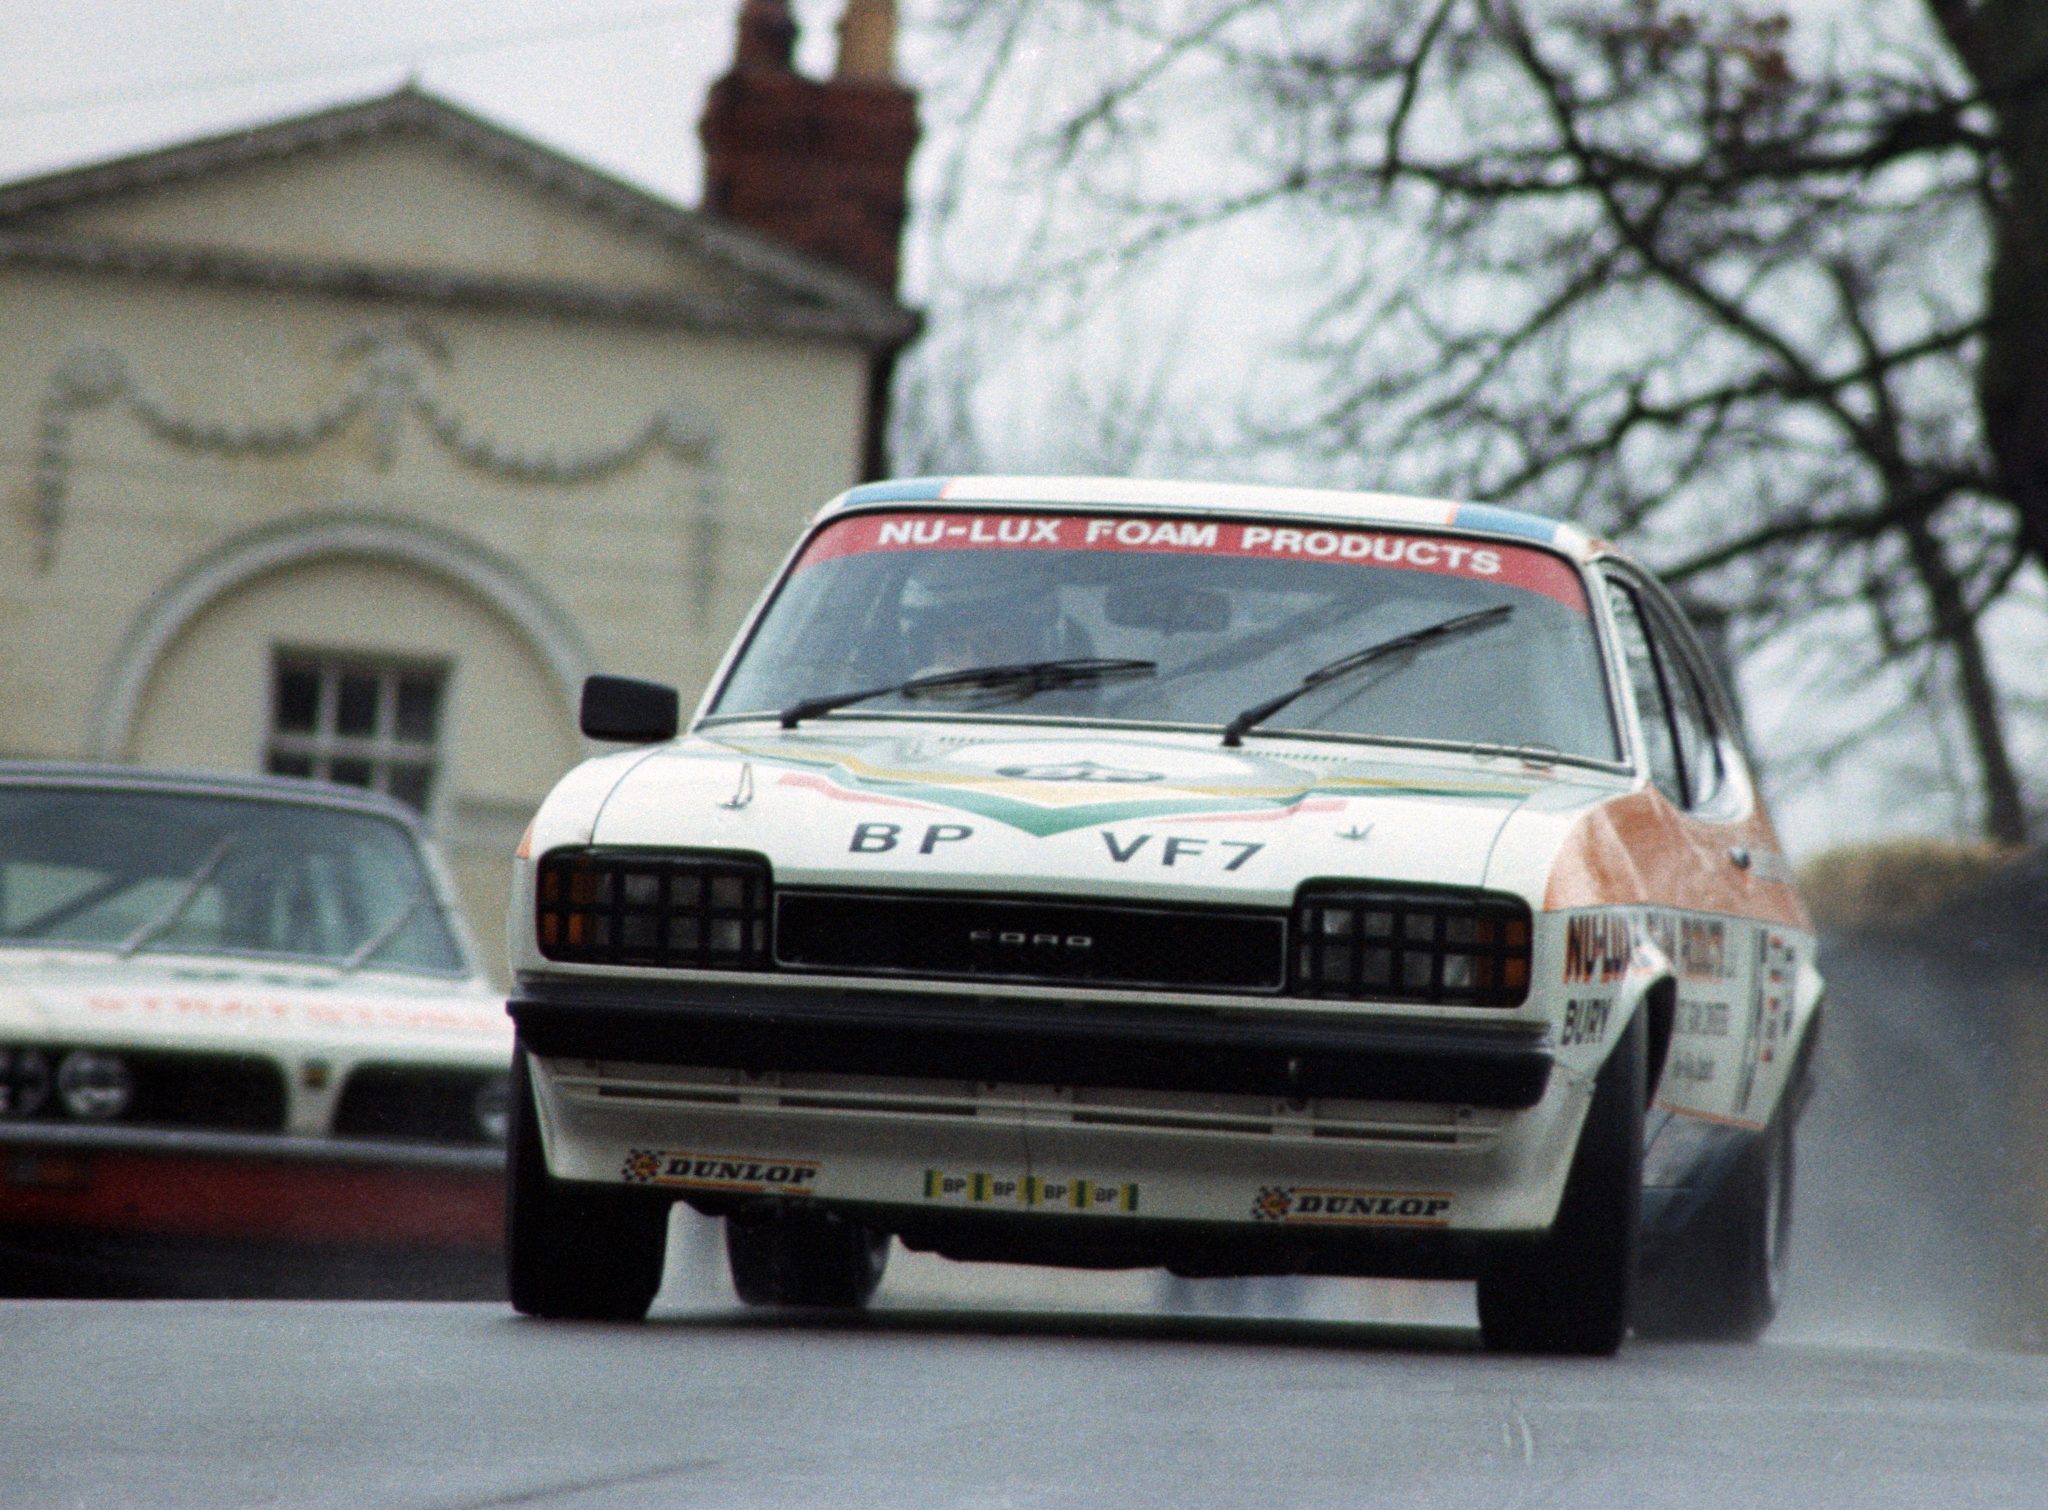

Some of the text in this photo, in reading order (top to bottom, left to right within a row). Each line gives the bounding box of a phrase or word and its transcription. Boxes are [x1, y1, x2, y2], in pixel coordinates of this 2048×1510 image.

[878, 519, 1503, 576] NU-LUX FOAM PRODUCTS
[848, 822, 1266, 872] BP VF7
[665, 1158, 817, 1185] DUNLOP
[943, 1177, 967, 1194] BP
[993, 1180, 1016, 1197] BP
[1044, 1184, 1067, 1200] BP
[1297, 1195, 1451, 1217] DUNLOP
